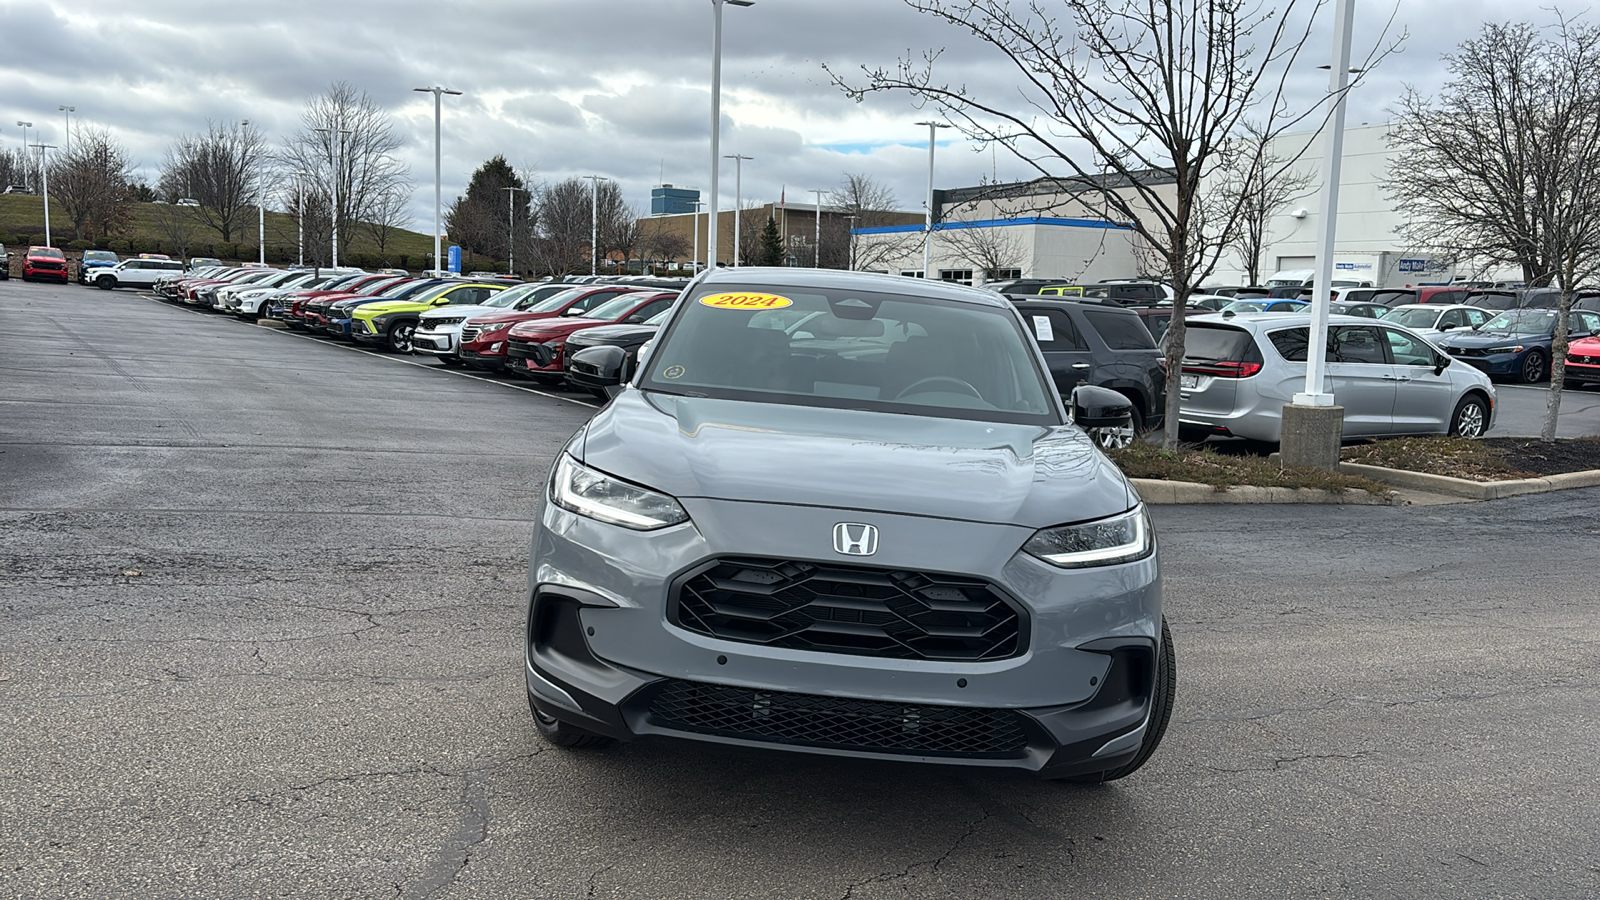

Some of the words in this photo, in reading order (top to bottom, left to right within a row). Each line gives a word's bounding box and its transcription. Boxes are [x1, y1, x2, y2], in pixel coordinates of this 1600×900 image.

[1400, 261, 1411, 271] Andy
[1412, 261, 1423, 270] Mohr
[714, 296, 778, 306] 2024
